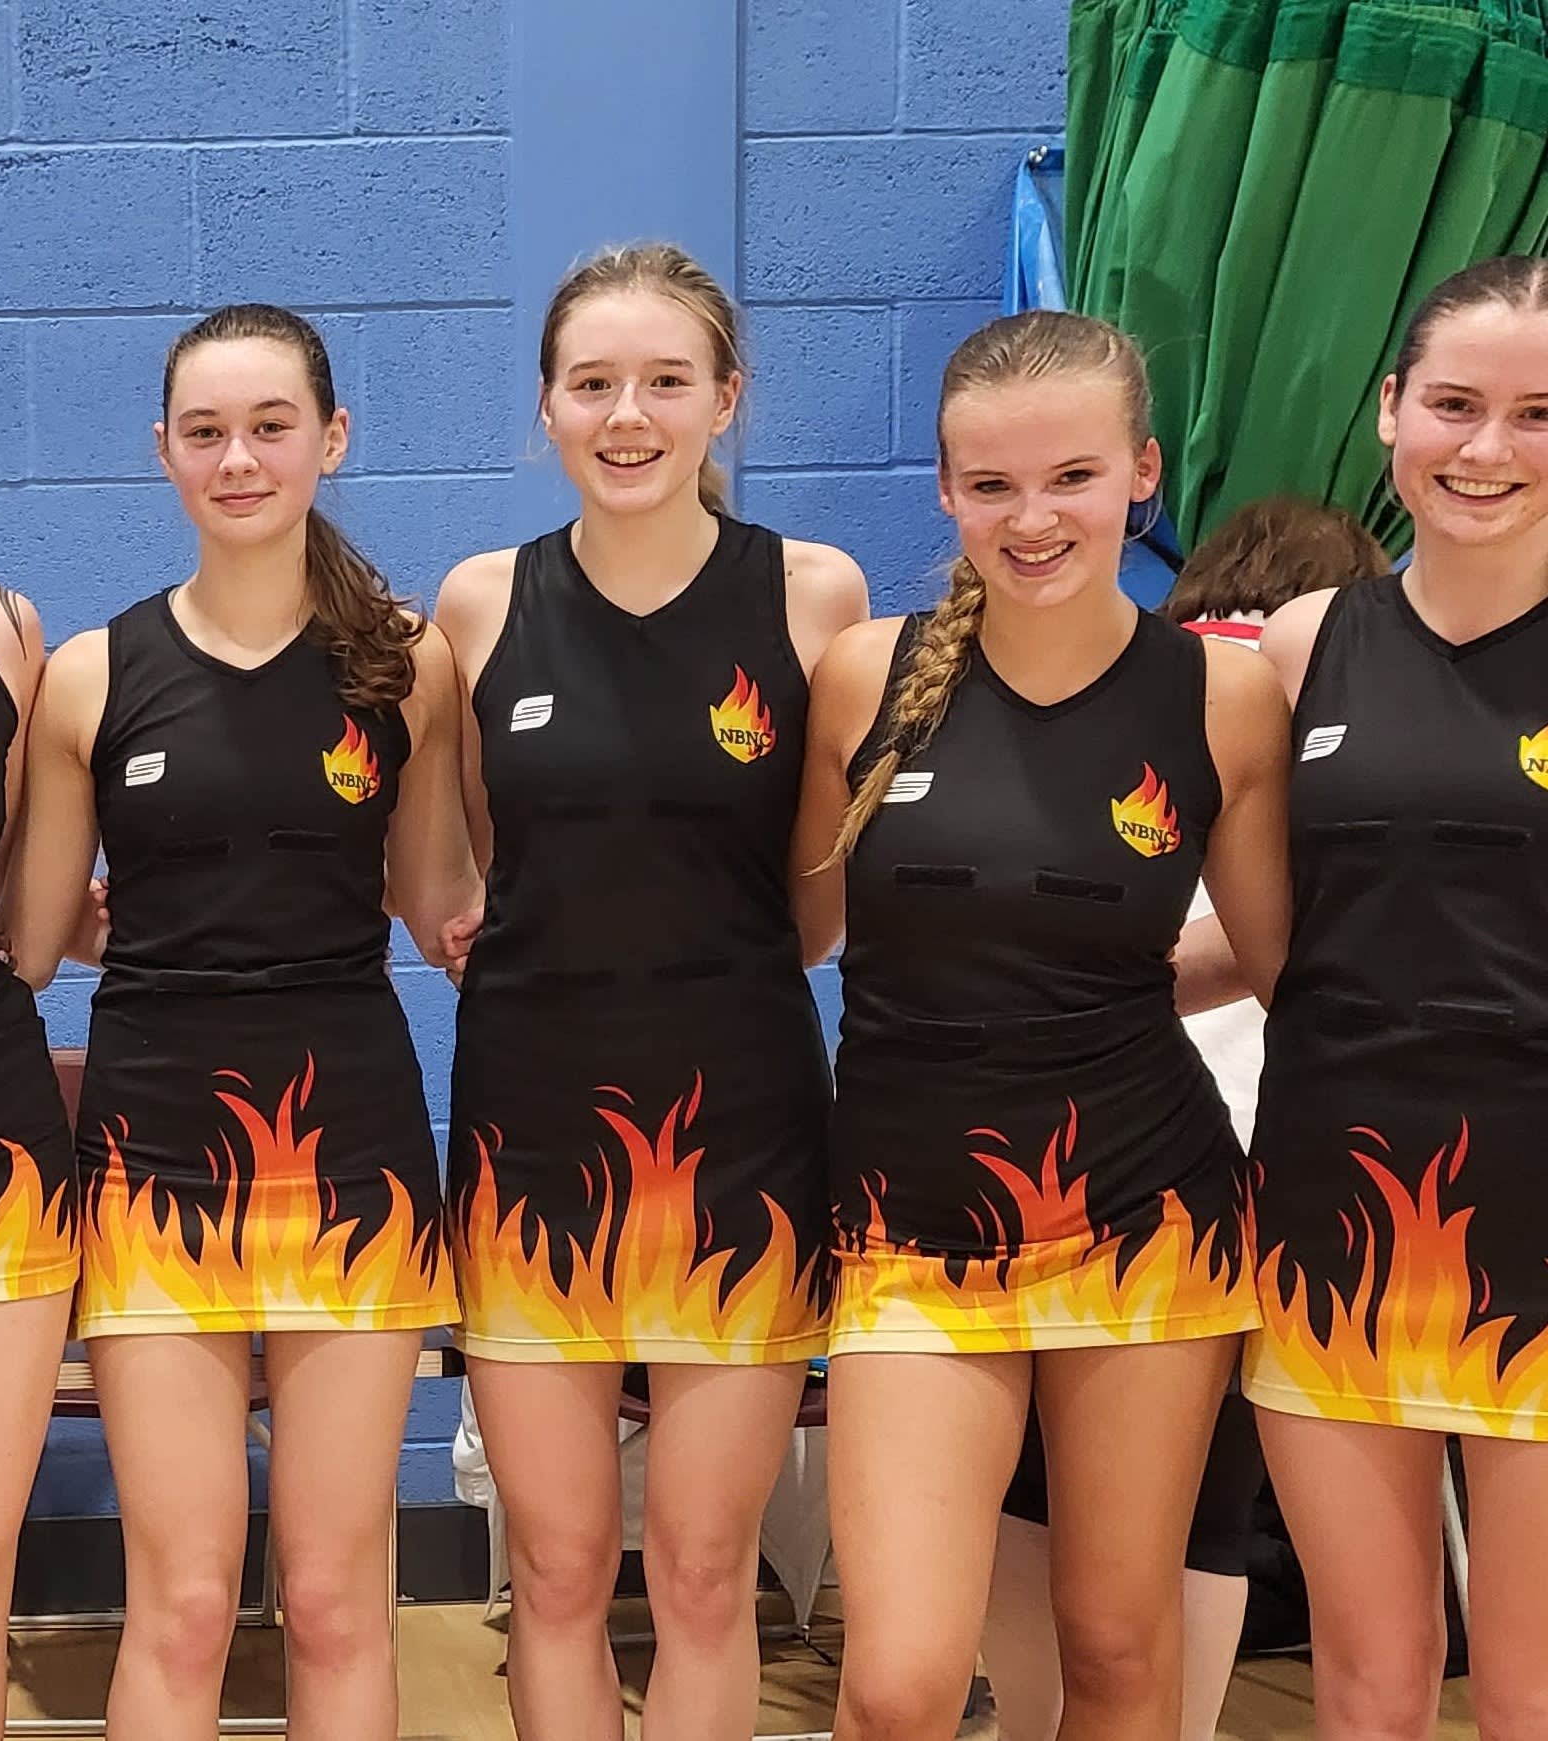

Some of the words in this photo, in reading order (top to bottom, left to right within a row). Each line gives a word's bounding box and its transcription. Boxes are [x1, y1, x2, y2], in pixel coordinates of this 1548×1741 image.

[718, 728, 772, 749] NBNC
[1526, 757, 1548, 773] N
[331, 772, 378, 791] NBNC
[1120, 821, 1178, 846] NBNC
